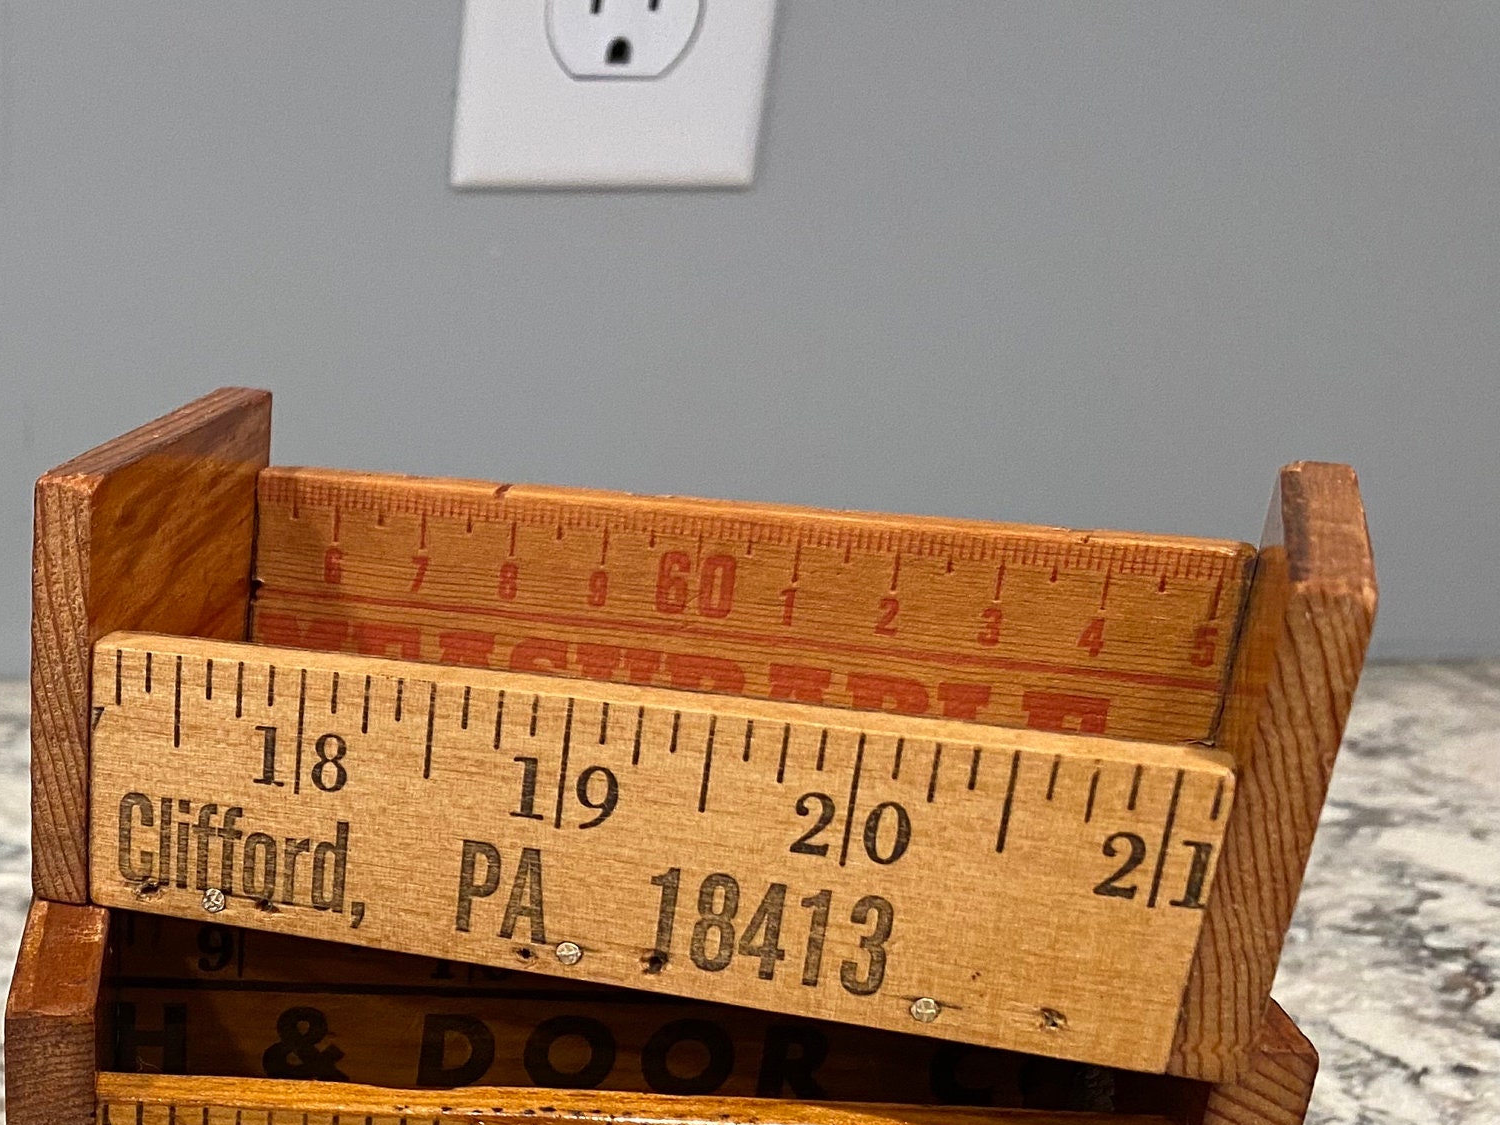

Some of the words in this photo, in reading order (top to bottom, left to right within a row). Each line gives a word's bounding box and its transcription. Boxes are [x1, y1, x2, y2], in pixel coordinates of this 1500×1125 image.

[323, 547, 344, 585] 6
[411, 555, 428, 594] 7
[499, 561, 519, 600] 8
[587, 569, 608, 608] 9
[654, 550, 738, 620] 60
[780, 587, 797, 627] 1
[875, 597, 901, 636] 2
[976, 606, 1001, 647] 3
[1077, 616, 1106, 658] 4
[253, 725, 349, 794] 18
[508, 756, 620, 830] 19
[789, 791, 913, 865] 20
[117, 791, 366, 930] Clifford,
[455, 838, 547, 946] PA
[650, 866, 895, 996] 18413
[263, 1006, 351, 1082] &
[417, 1012, 829, 1100] DOOR
